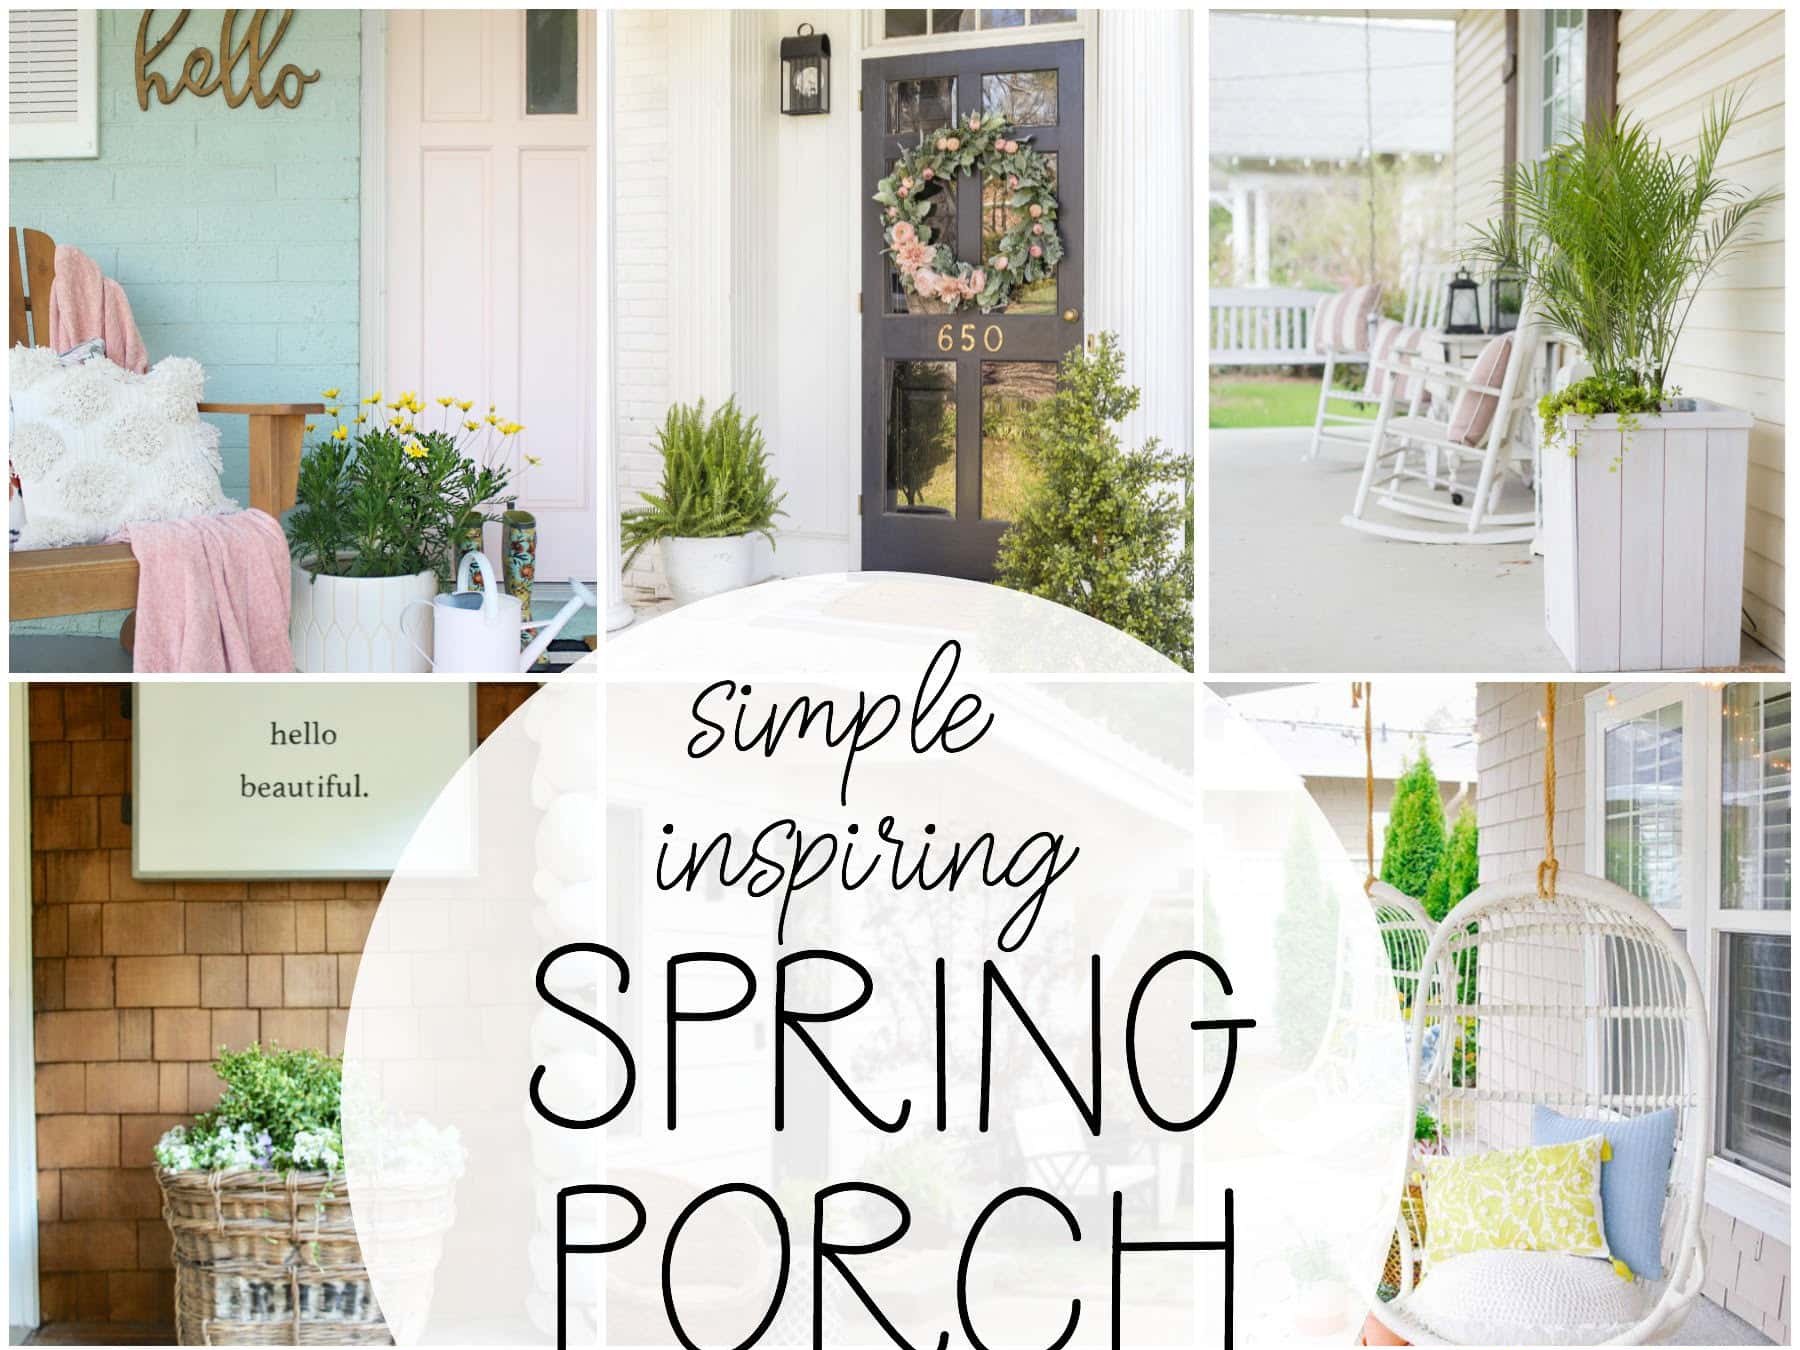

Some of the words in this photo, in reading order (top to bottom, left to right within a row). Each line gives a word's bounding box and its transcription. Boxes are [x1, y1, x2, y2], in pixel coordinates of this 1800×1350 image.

[134, 8, 321, 112] hello
[937, 323, 1004, 353] 650
[270, 721, 337, 746] hello
[240, 773, 369, 799] beautiful.
